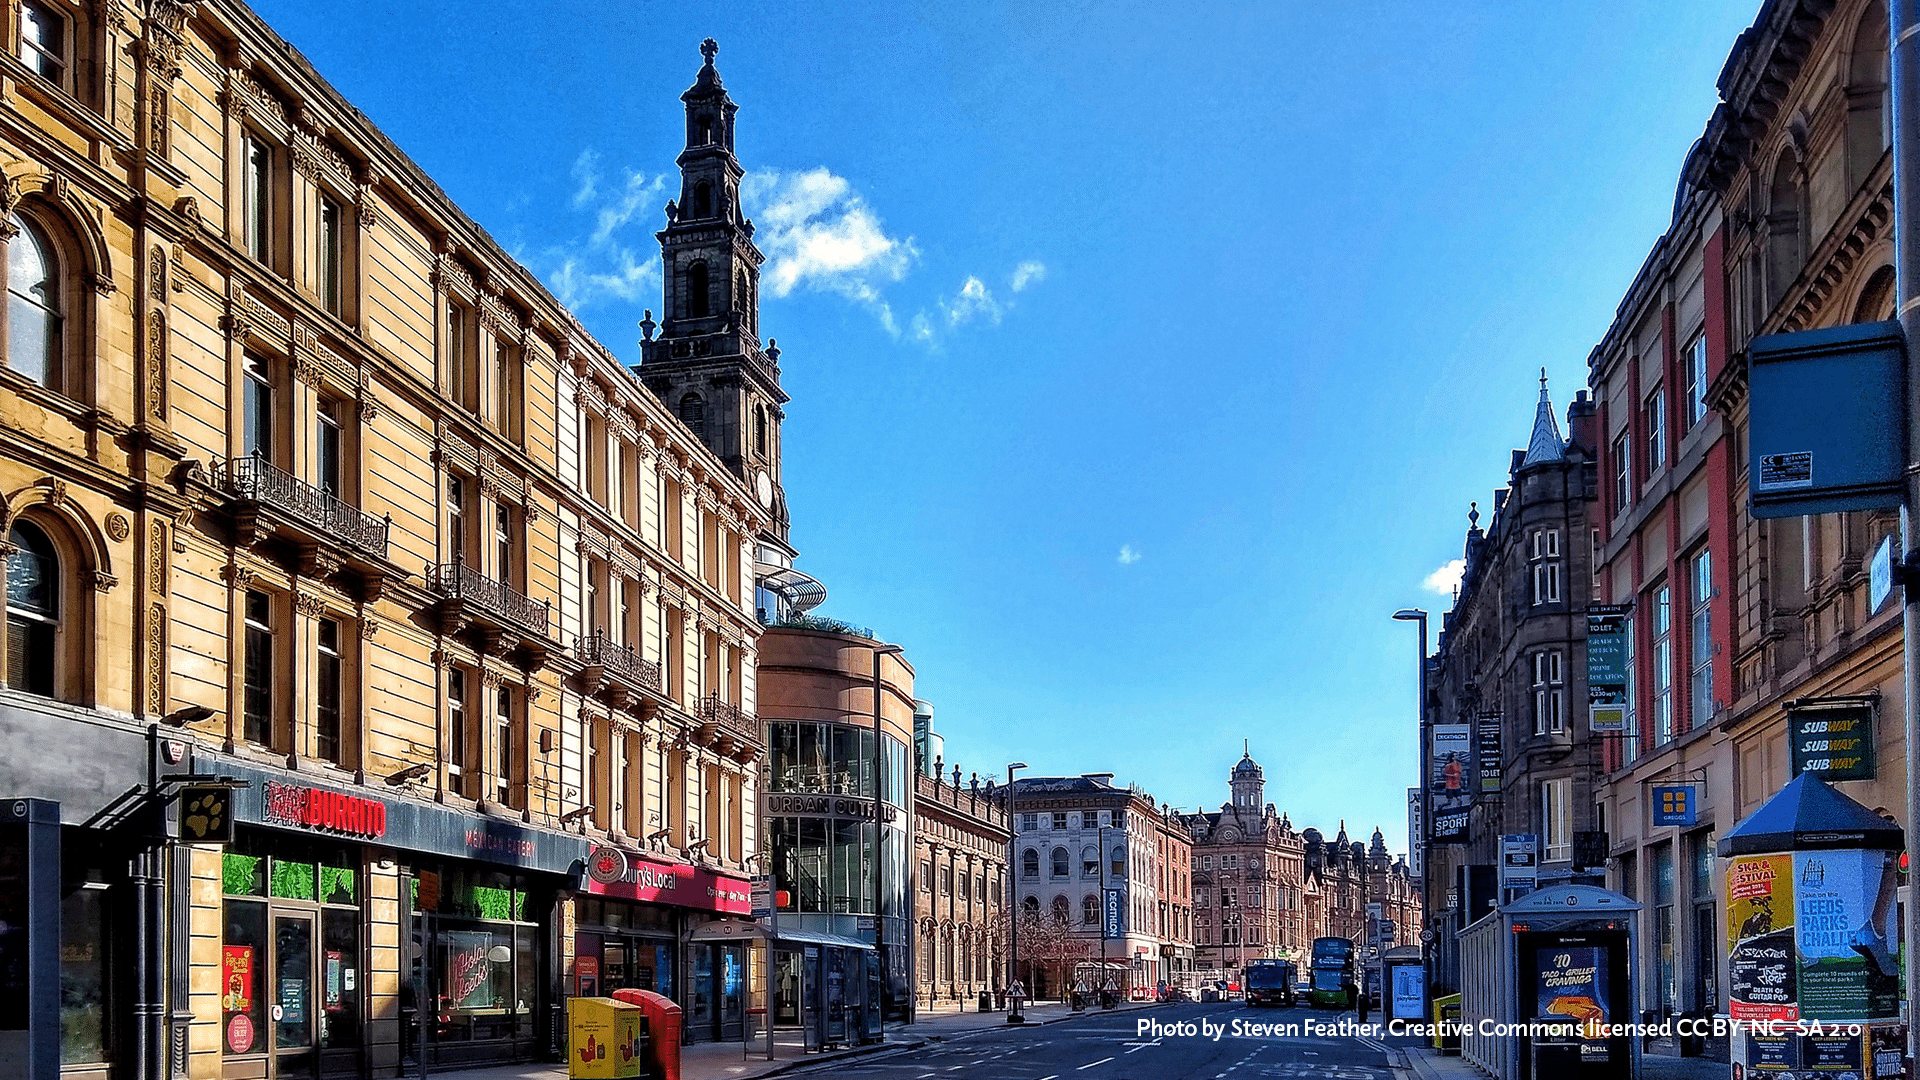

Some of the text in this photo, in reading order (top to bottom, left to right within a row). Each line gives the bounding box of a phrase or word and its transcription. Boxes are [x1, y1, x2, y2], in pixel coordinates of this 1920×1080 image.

[1800, 719, 1859, 734] SUBWAY
[1801, 739, 1860, 752] SUBWAY
[1803, 757, 1861, 771] SUBWAY
[1490, 769, 1500, 777] LET
[768, 797, 830, 813] URBAN
[1436, 817, 1468, 832] SPORT
[1738, 861, 1770, 873] SKA &
[652, 868, 676, 889] Local
[1109, 891, 1117, 937] DECATHLON
[1802, 899, 1844, 916] LEEDS
[1802, 915, 1849, 932] PARKS
[1565, 967, 1597, 977] GRILLER
[1546, 975, 1592, 987] CRAVINGS
[1749, 993, 1773, 1001] GUITAR
